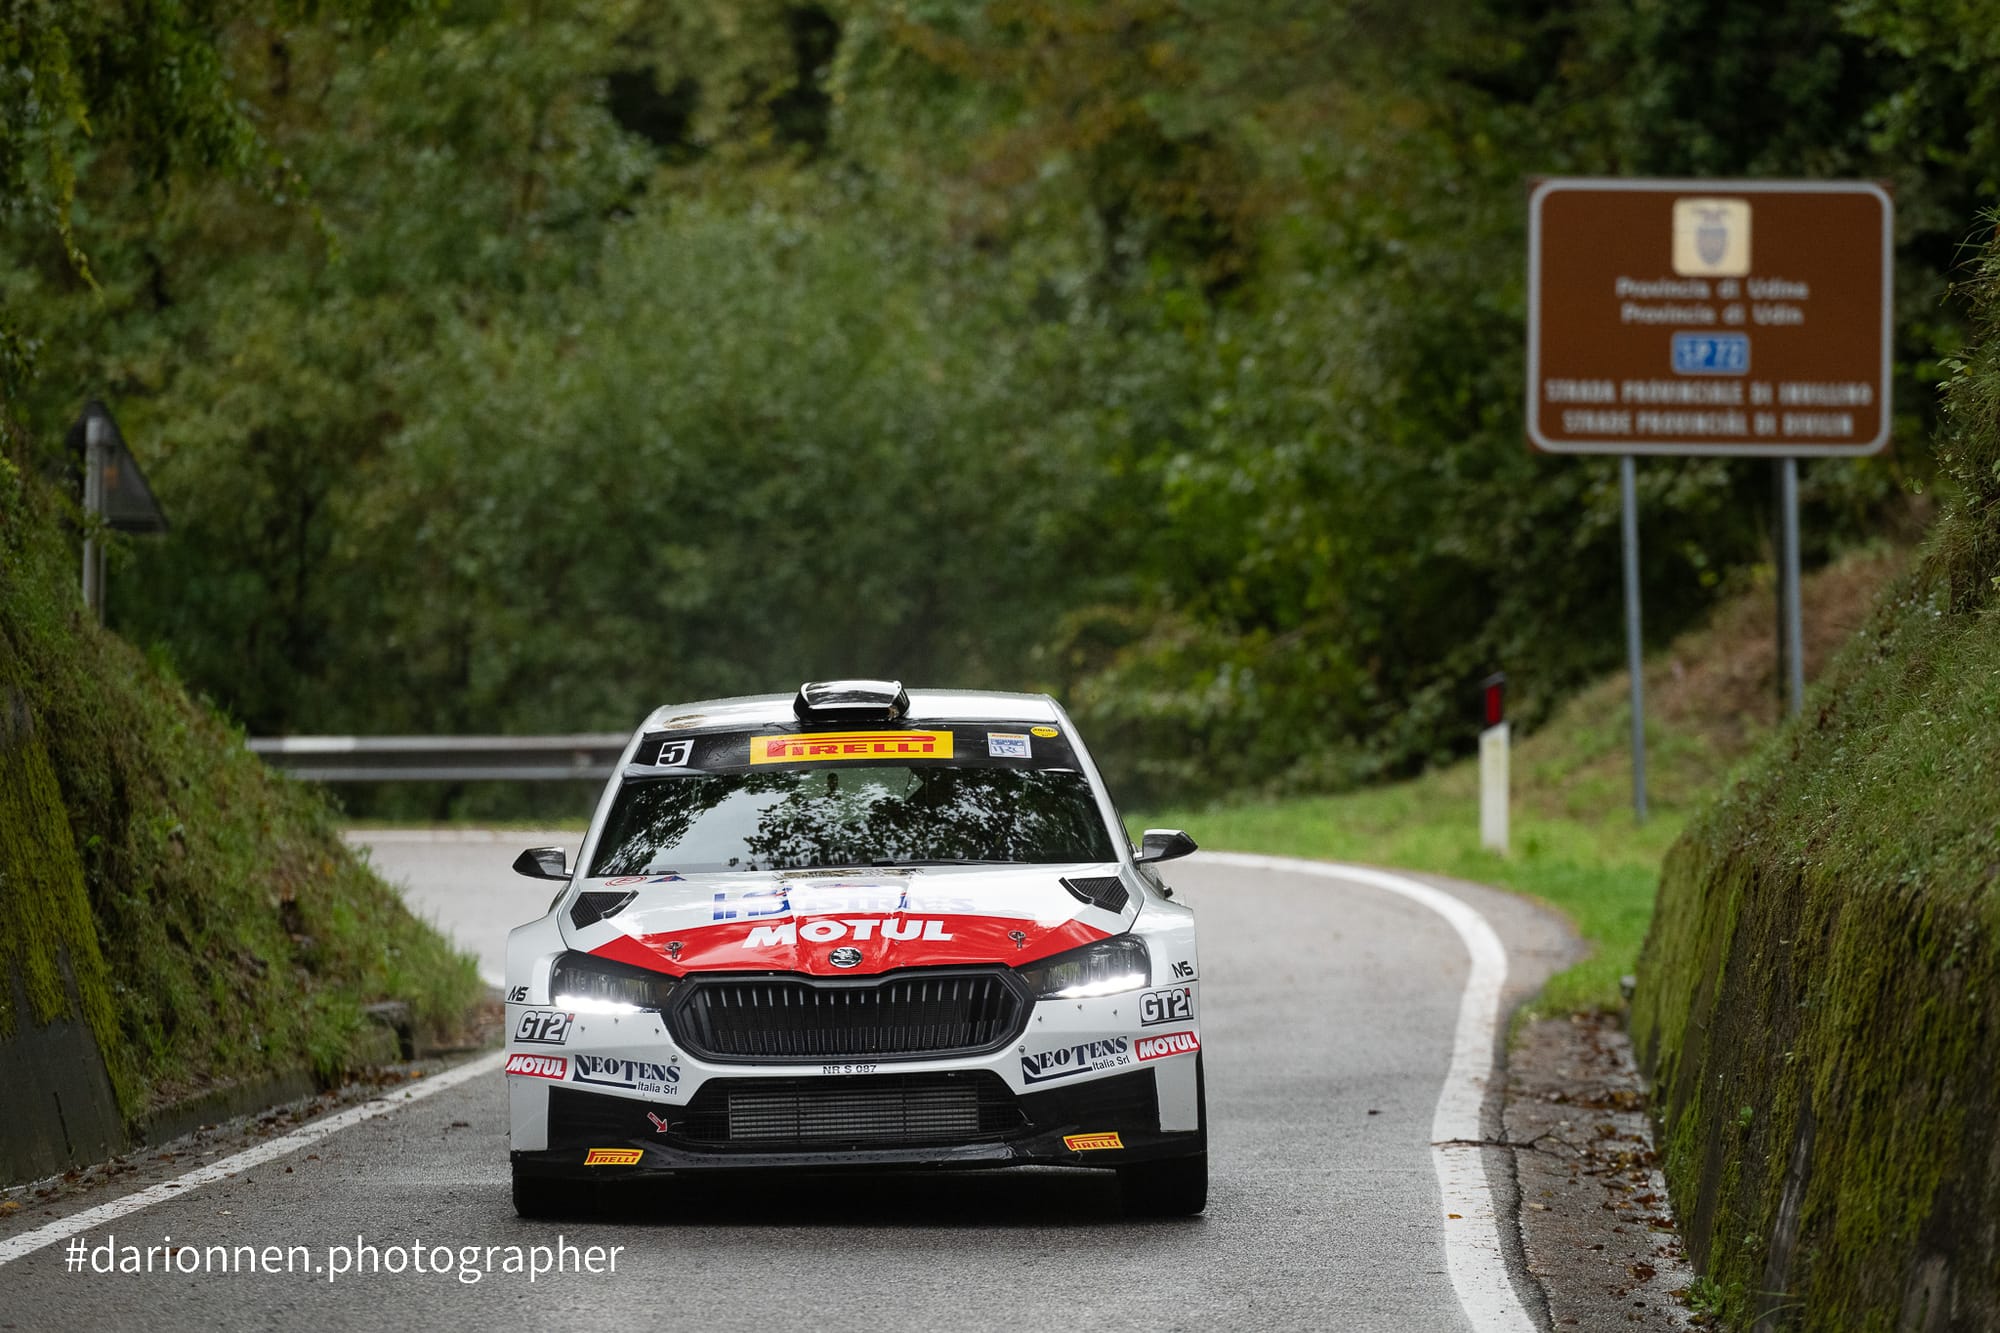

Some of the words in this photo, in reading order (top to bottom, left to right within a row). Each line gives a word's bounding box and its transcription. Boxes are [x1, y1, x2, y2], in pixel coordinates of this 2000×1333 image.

[1616, 277, 1710, 298] Provincia
[1717, 278, 1740, 298] di
[1747, 278, 1809, 299] Udine
[1723, 304, 1745, 325] di
[1752, 304, 1803, 325] Udin
[1545, 379, 1615, 402] STRADA
[659, 742, 686, 765] 5
[767, 735, 936, 757] PIRELLI
[741, 919, 954, 949] MOTUL
[1139, 988, 1194, 1023] GT2i
[515, 1011, 575, 1042] GT2i
[1021, 1036, 1128, 1078] NEOTENS
[1139, 1034, 1199, 1059] MOTUL
[506, 1056, 565, 1077] MOTUL
[573, 1054, 681, 1084] NEOTENS
[1092, 1057, 1115, 1071] Italia
[1117, 1055, 1131, 1065] Srl
[637, 1081, 661, 1093] Italia
[663, 1084, 678, 1096] Srl
[1066, 1135, 1119, 1149] PIRELLI
[586, 1151, 640, 1163] PIRELLI
